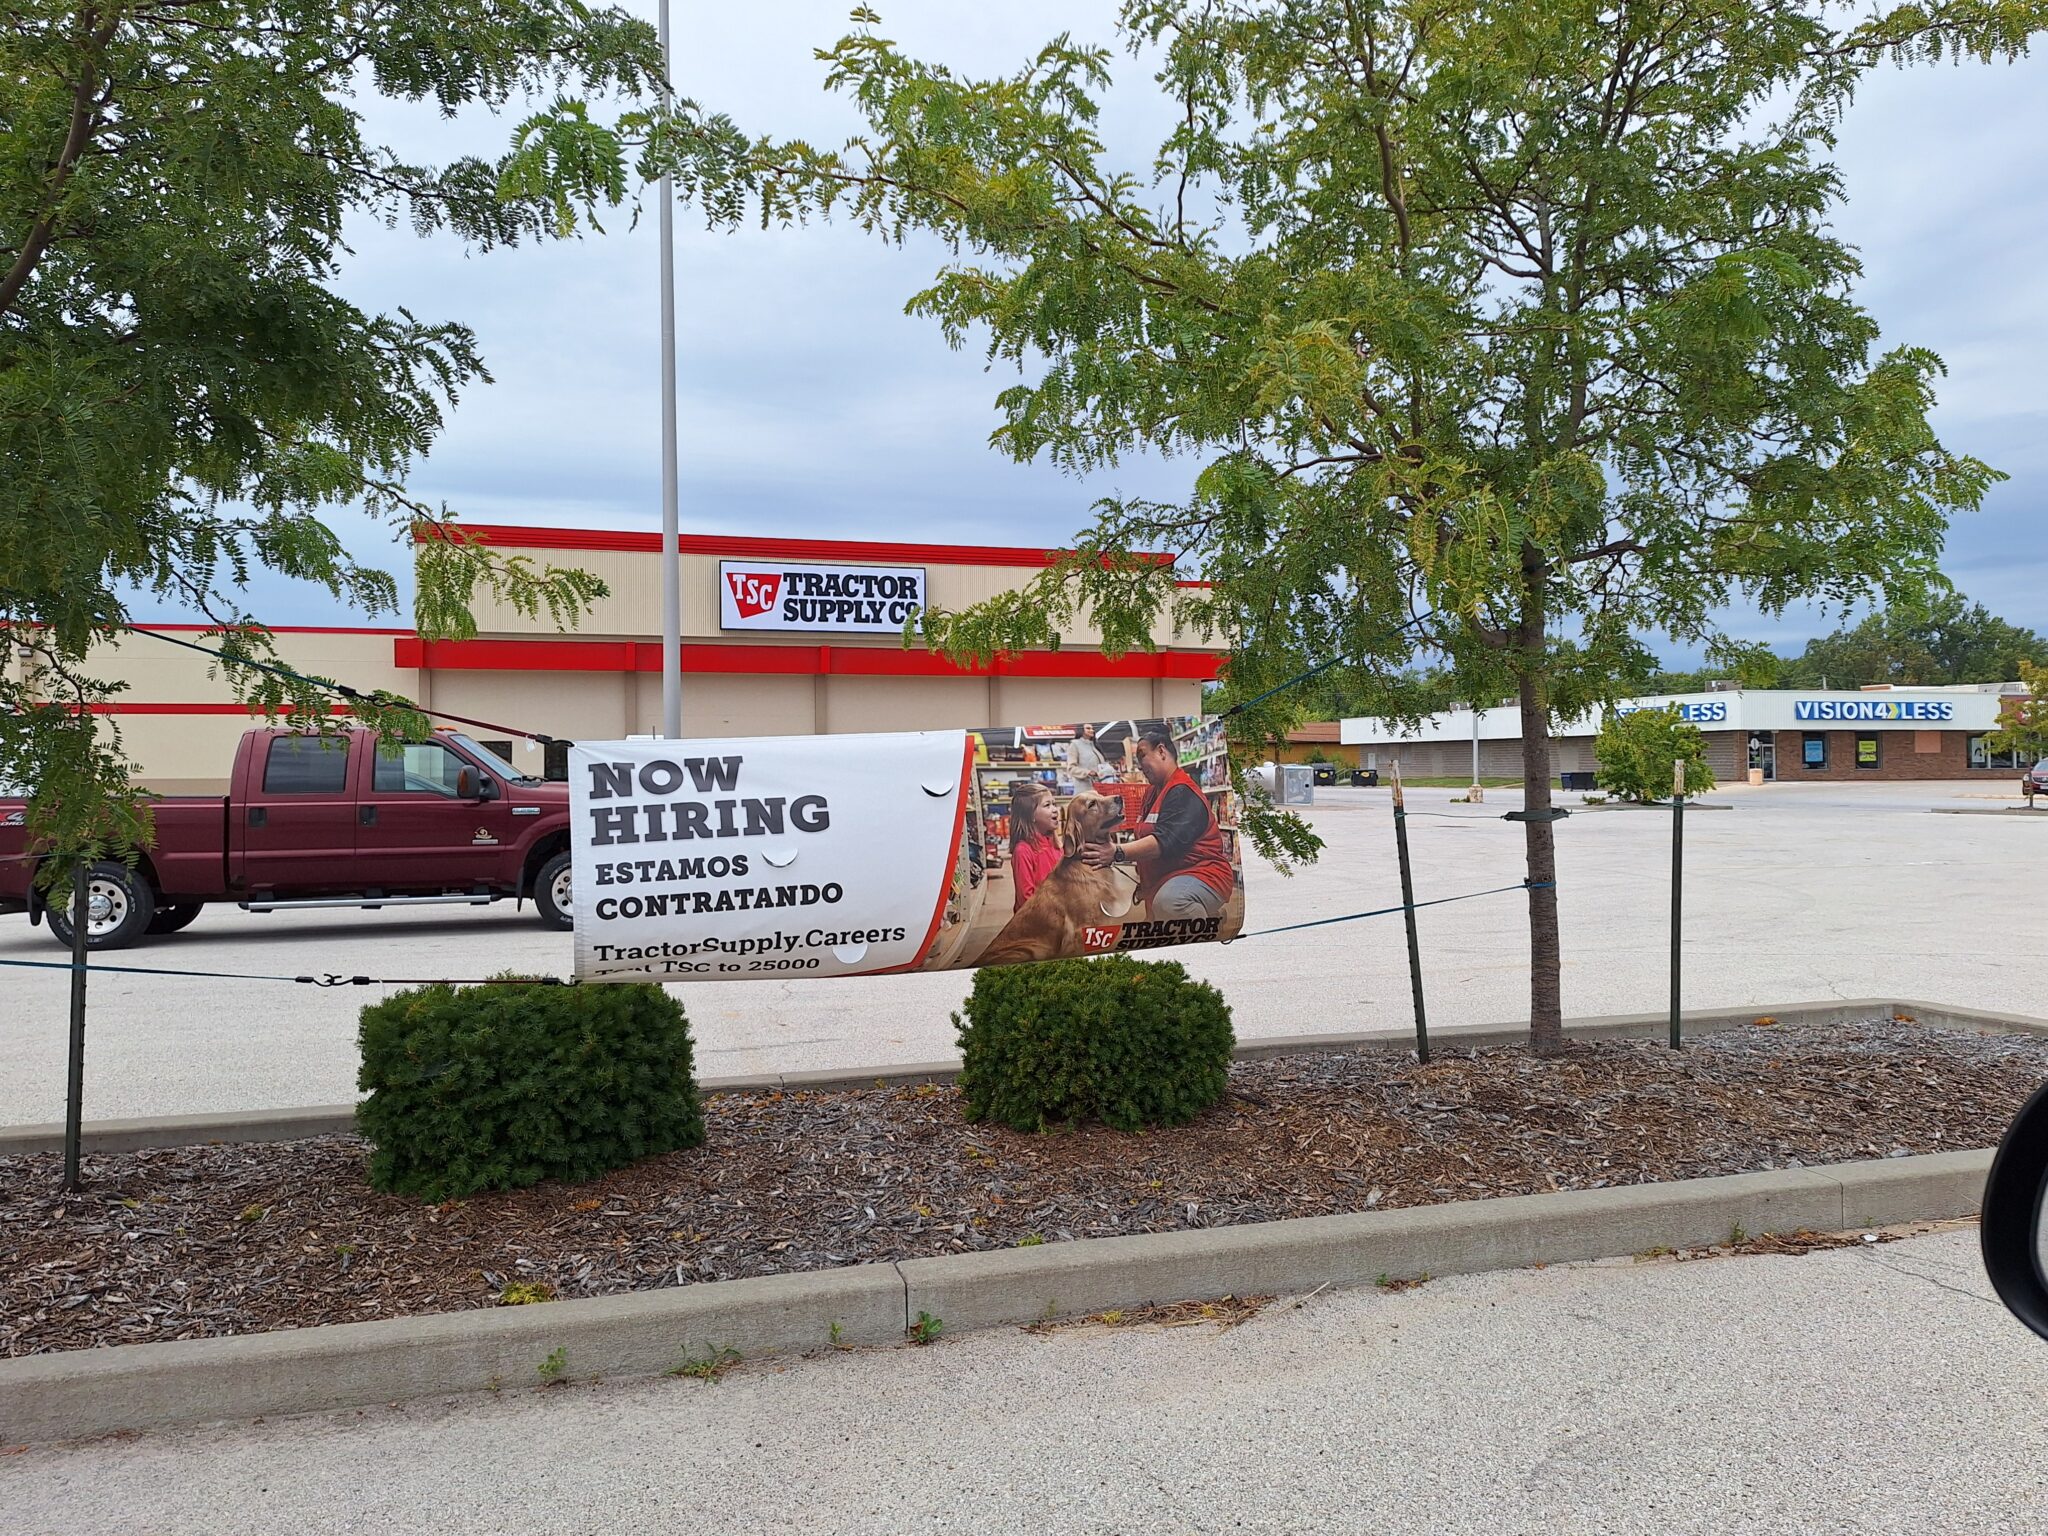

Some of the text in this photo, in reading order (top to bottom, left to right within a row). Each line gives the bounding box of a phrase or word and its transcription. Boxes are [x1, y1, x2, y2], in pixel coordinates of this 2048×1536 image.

[732, 574, 773, 611] TSC
[783, 573, 919, 599] TRACTOR
[783, 598, 887, 624] SUPPLY
[588, 755, 743, 799] NOW
[590, 795, 830, 846] HIRING
[595, 854, 749, 885] ESTAMOS
[596, 882, 843, 920] CONTRATANDO
[593, 925, 906, 962] TractorSupply.Careers
[1085, 927, 1113, 948] TSC
[1121, 917, 1221, 939] TRACTOR
[660, 961, 711, 973] TSC
[718, 962, 741, 972] to
[748, 958, 821, 972] 25000
